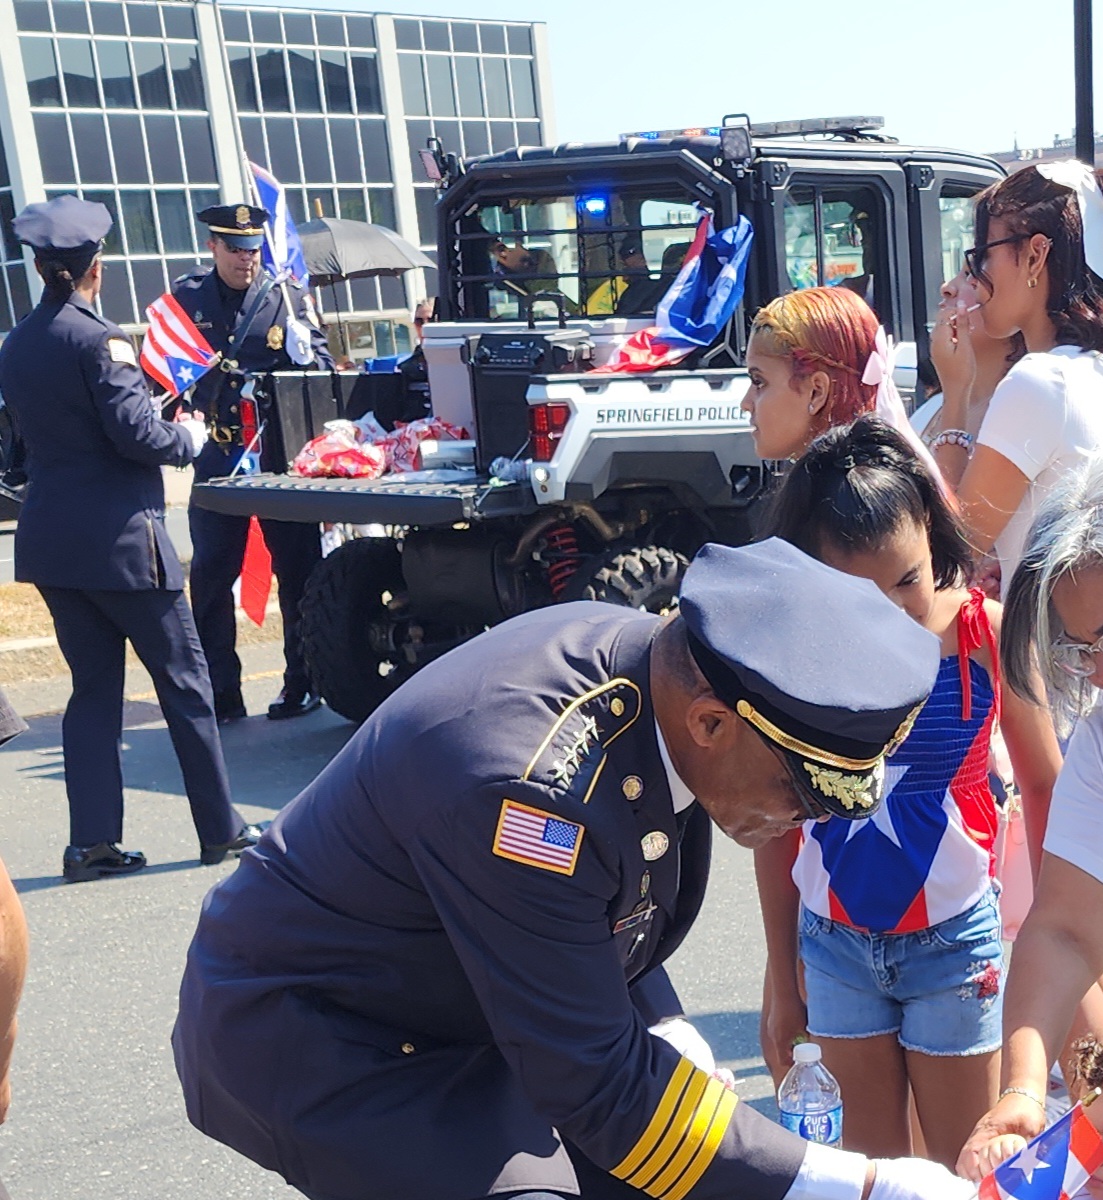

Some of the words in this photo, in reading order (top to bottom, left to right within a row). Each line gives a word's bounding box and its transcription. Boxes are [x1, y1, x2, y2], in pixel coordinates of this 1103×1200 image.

[596, 408, 693, 424] SPRINGFIELD
[698, 406, 747, 421] POLICE
[804, 1115, 828, 1127] Pure
[807, 1124, 827, 1137] Life
